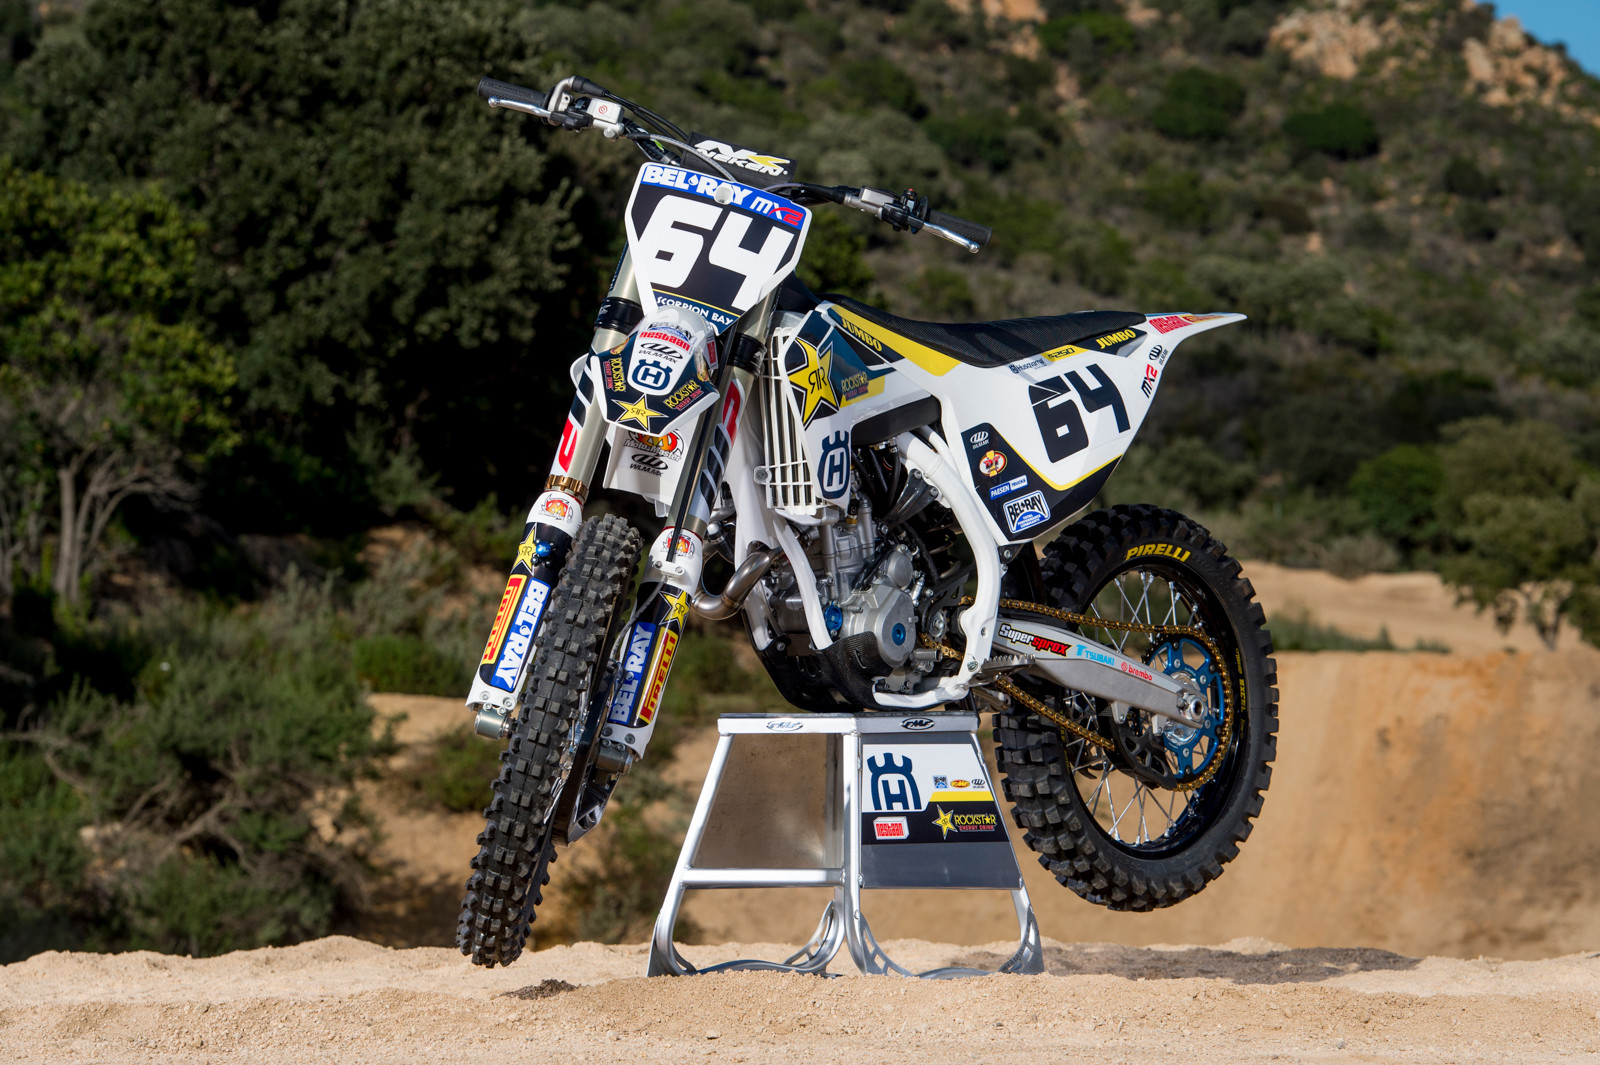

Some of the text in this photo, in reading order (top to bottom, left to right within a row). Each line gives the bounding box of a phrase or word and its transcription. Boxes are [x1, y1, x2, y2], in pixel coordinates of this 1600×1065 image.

[749, 196, 804, 226] MX2
[636, 194, 796, 311] 64
[711, 312, 734, 326] BAY
[841, 318, 883, 352] JUMBO
[1095, 329, 1137, 350] JUMBO
[1028, 363, 1131, 464] 64
[990, 483, 1010, 498] PAESEN
[1125, 543, 1191, 562] PIRELLI
[1085, 651, 1115, 666] TSUBAKI
[1128, 665, 1153, 681] brembo
[954, 814, 996, 825] ROCKSTAR
